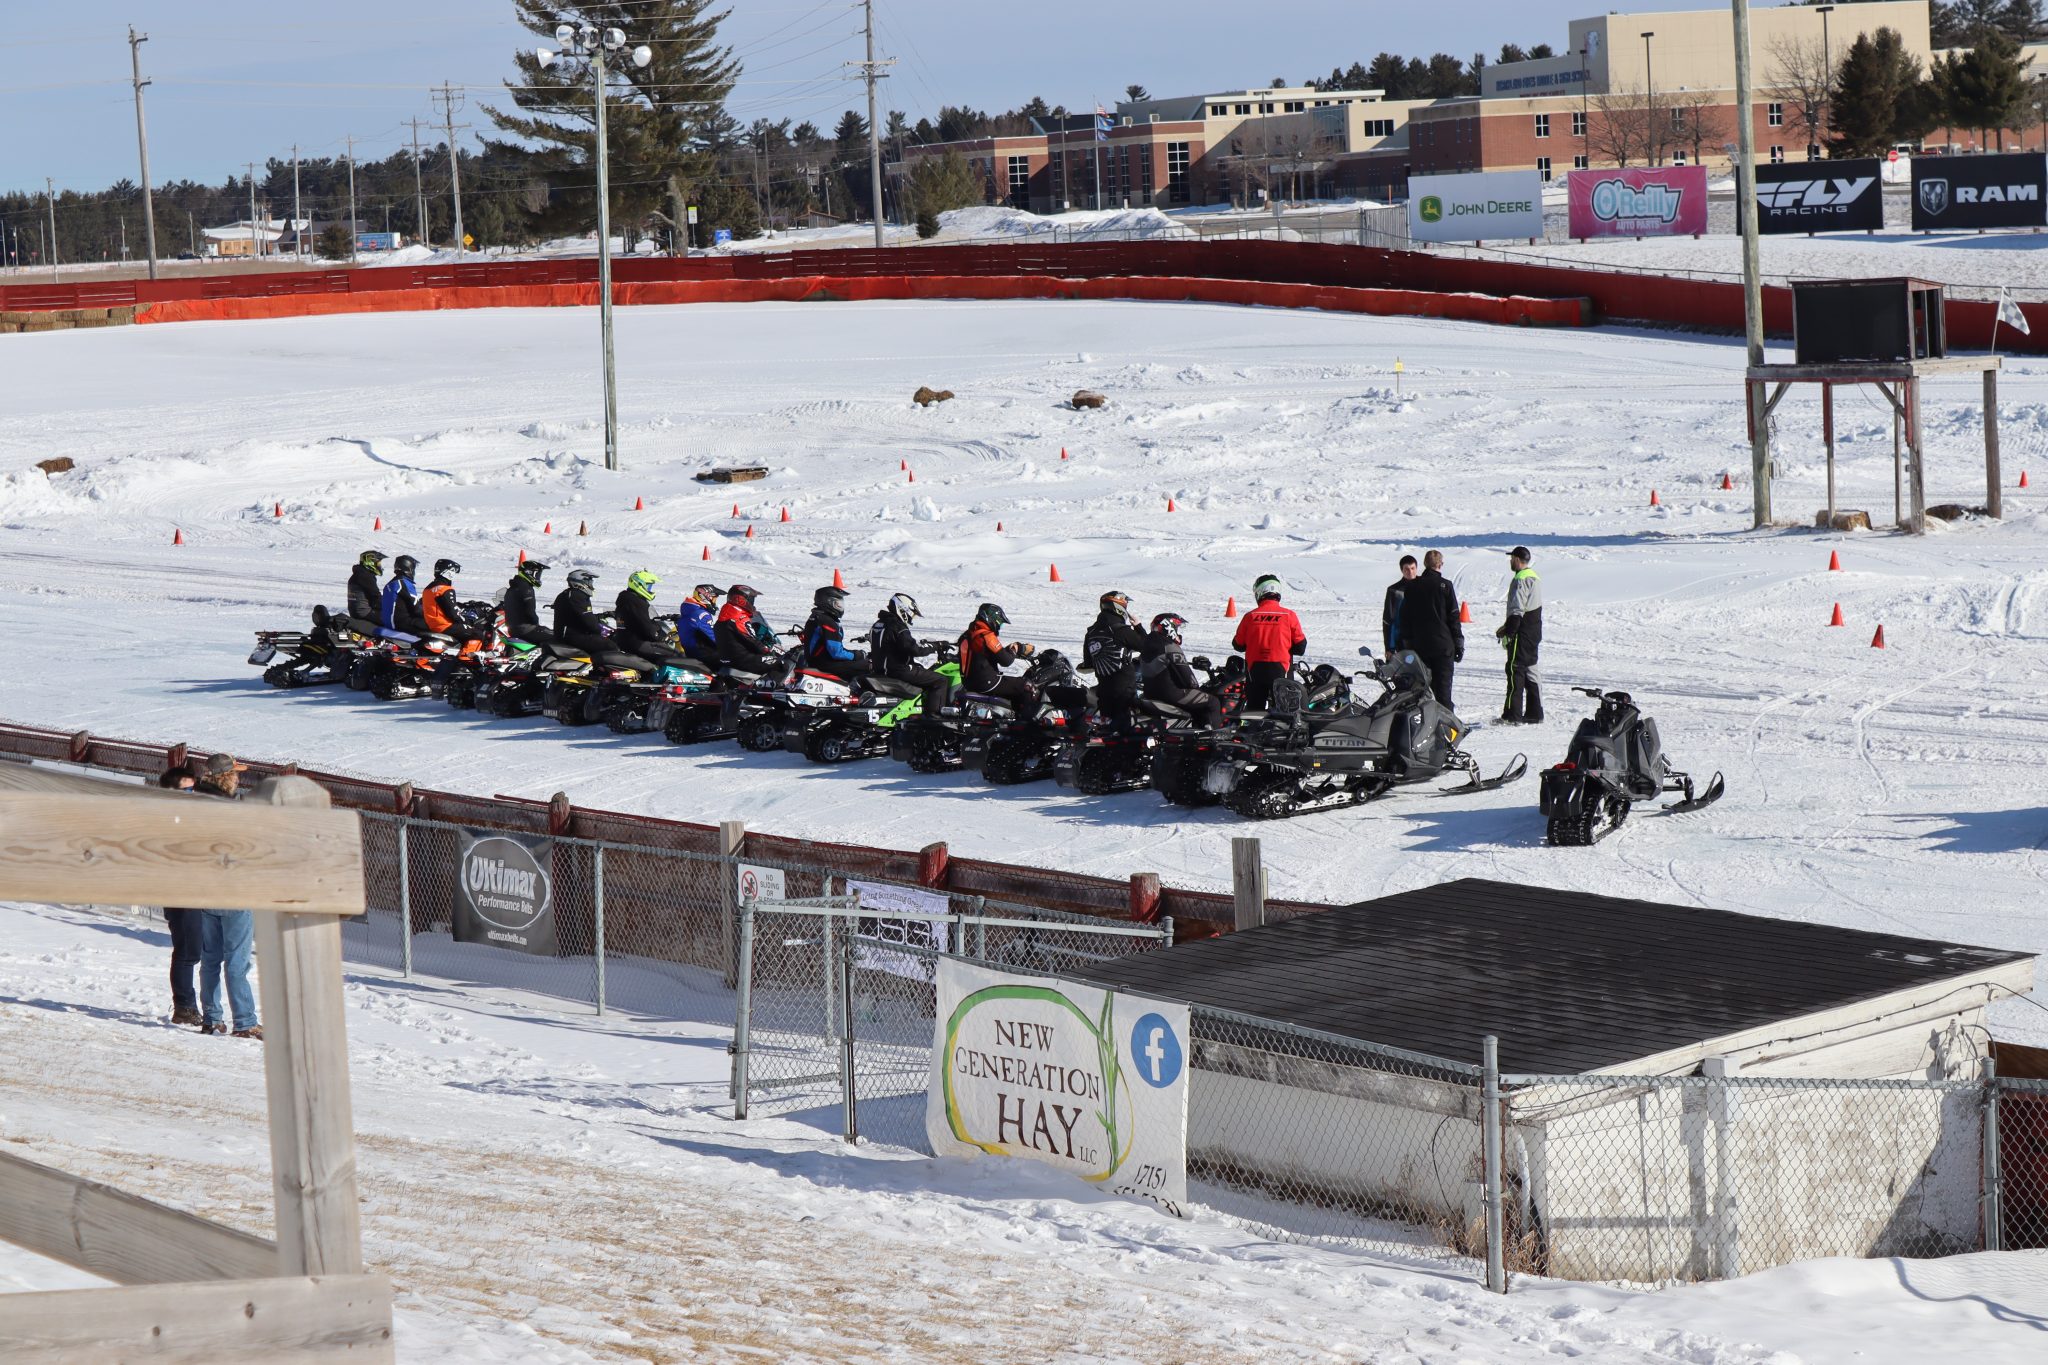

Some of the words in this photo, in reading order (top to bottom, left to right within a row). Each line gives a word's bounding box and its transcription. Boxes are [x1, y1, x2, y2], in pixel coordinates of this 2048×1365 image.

[1772, 176, 1877, 208] FLY
[1955, 184, 2038, 204] RAM
[1448, 202, 1484, 216] JOHN
[1487, 200, 1533, 214] DEERE
[1592, 180, 1681, 222] O'Reilly
[1770, 205, 1848, 216] RACING
[1616, 220, 1636, 230] AUTO
[1636, 219, 1661, 230] PARTS
[1253, 614, 1282, 623] LYNX
[814, 682, 824, 693] 20
[867, 709, 880, 723] 15
[1321, 738, 1366, 747] TITAN
[470, 855, 537, 900] Ultimax
[760, 880, 780, 890] SLIDING
[765, 873, 774, 881] NO
[478, 894, 521, 912] Performance
[994, 1019, 1054, 1052] NEW
[955, 1046, 1100, 1102] GENERATION
[997, 1093, 1082, 1159] HAY
[1080, 1146, 1097, 1165] LLC
